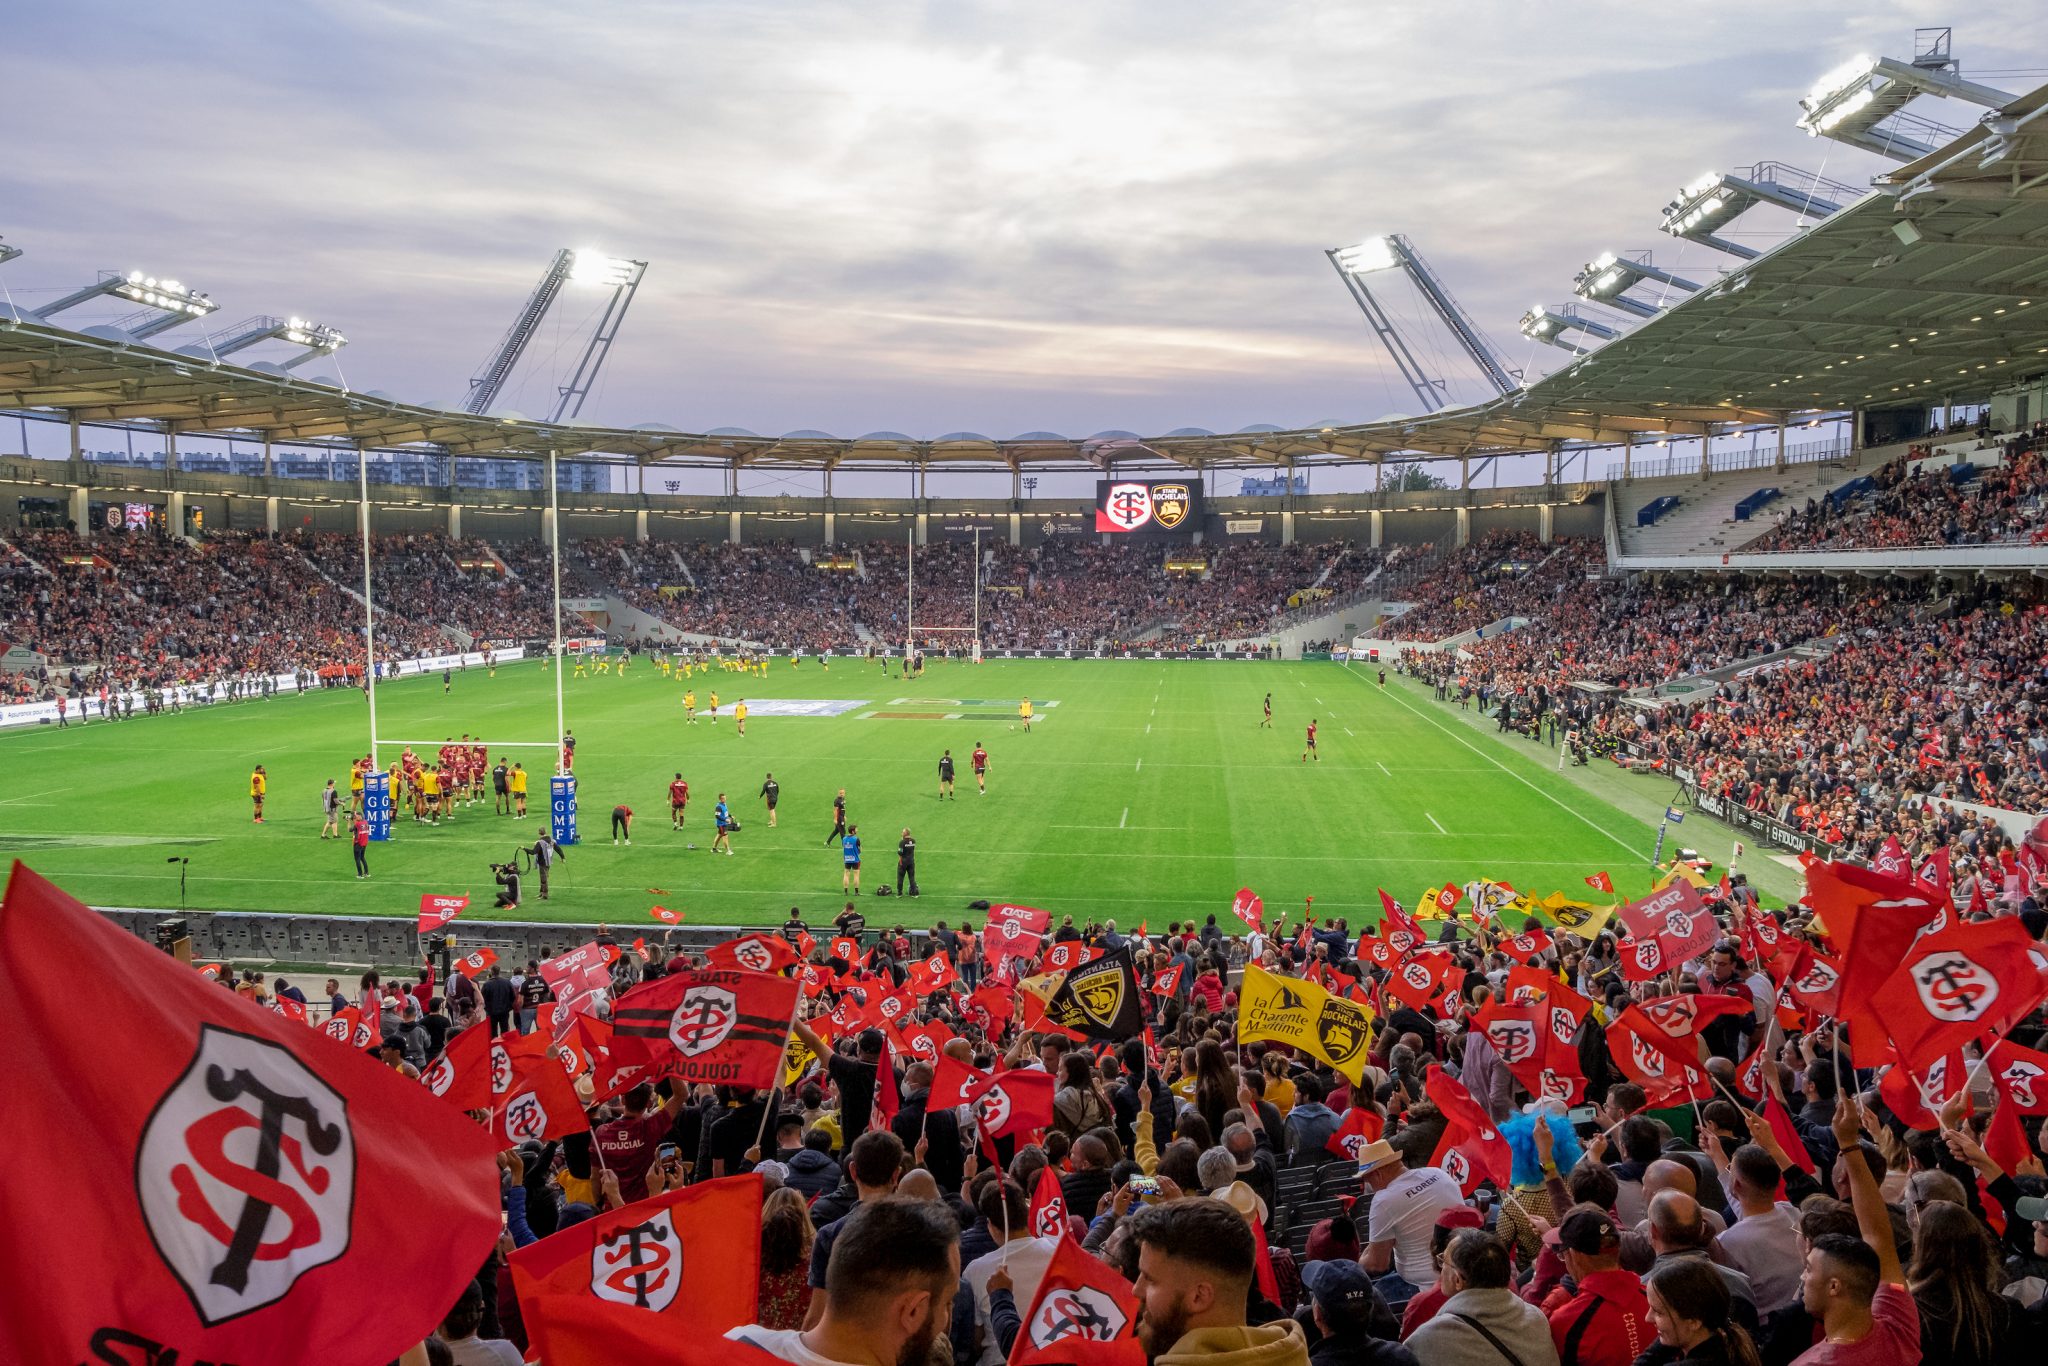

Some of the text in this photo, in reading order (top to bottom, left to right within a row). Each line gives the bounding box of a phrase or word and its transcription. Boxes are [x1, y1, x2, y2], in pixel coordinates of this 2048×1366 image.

[554, 800, 566, 840] GMF
[433, 898, 464, 907] STADE
[1254, 997, 1267, 1008] La
[1250, 1009, 1309, 1025] Charente
[1335, 1005, 1356, 1017] STADE
[1321, 1010, 1367, 1031] ROCHELAIS
[1246, 1020, 1304, 1037] Maritime
[601, 1139, 645, 1150] FIDUCIAL
